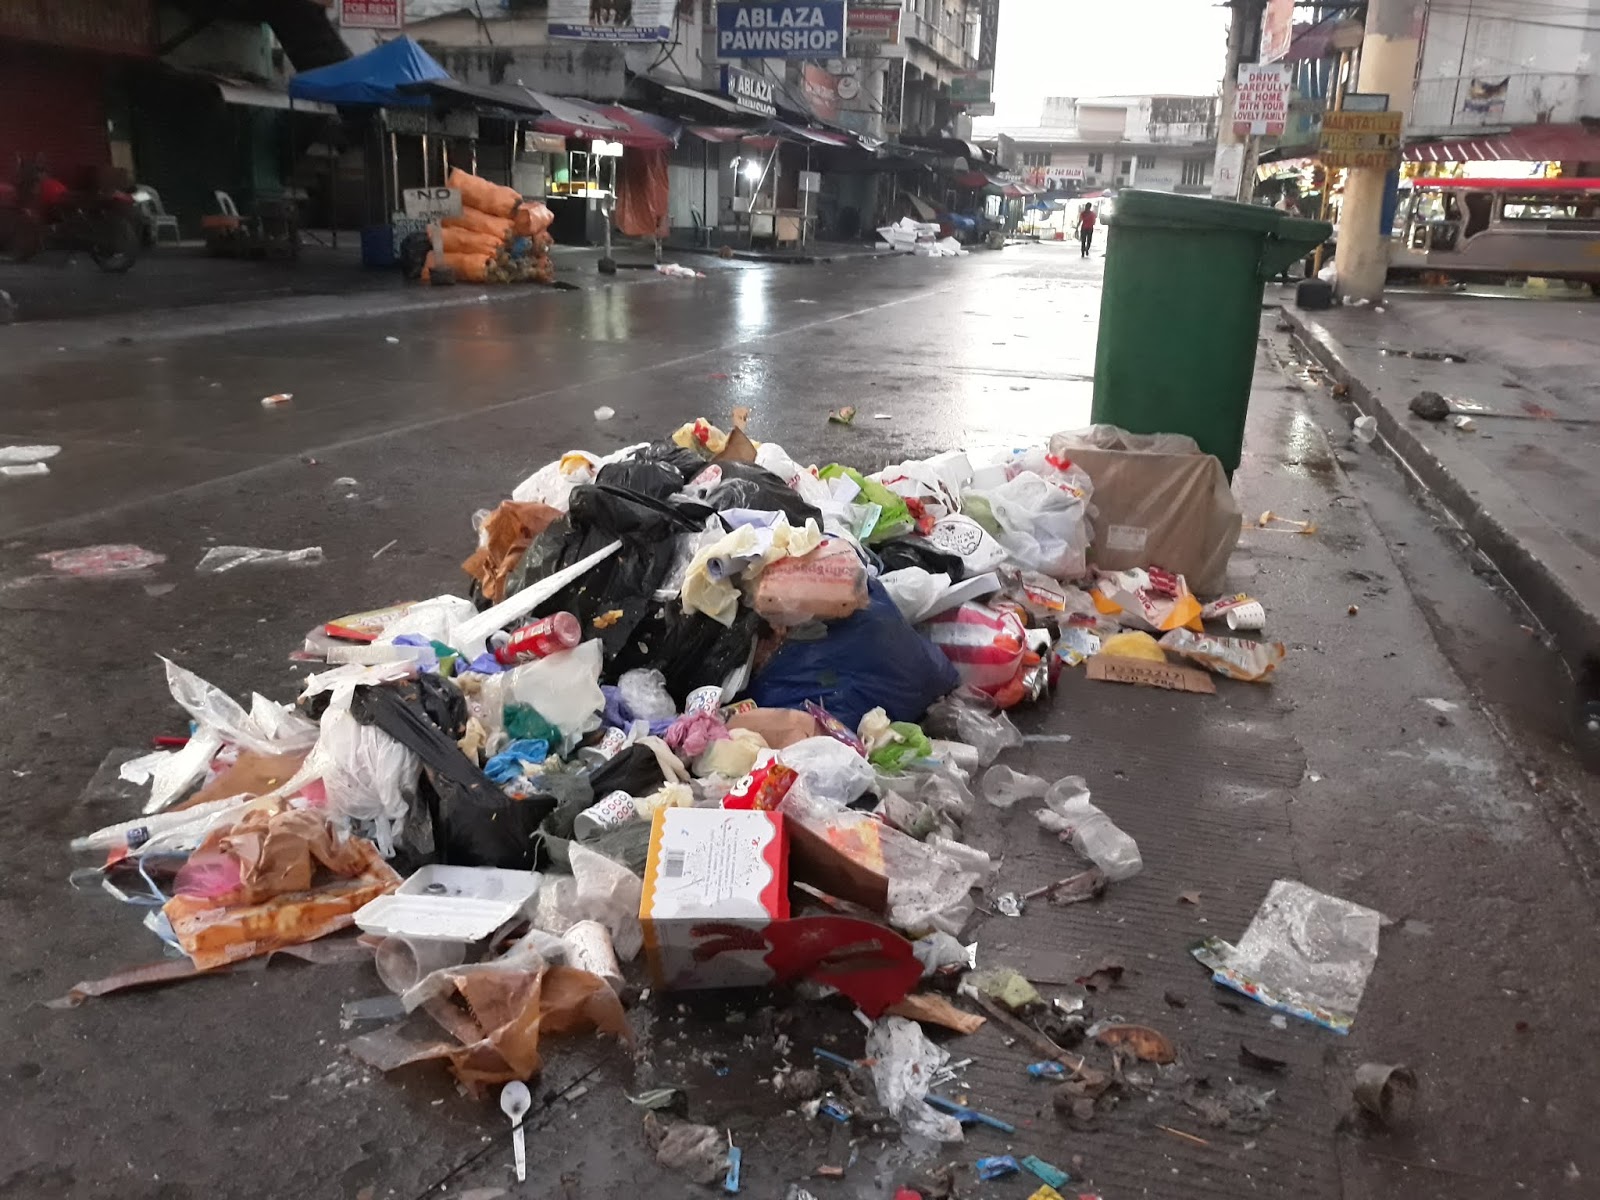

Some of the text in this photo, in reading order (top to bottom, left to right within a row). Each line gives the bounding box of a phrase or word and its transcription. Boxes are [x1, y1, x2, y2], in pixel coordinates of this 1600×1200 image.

[344, 3, 396, 16] FOR RENT
[735, 7, 825, 28] ABLAZA
[721, 30, 839, 50] PAWNSHOP
[1249, 72, 1281, 82] DRIVE
[1237, 82, 1290, 92] CAREFULLY
[1240, 92, 1282, 102] BE HOME
[1239, 102, 1284, 111] WITH YOUR
[1233, 111, 1287, 121] LOVELY FAMILY
[417, 188, 451, 201] NO
